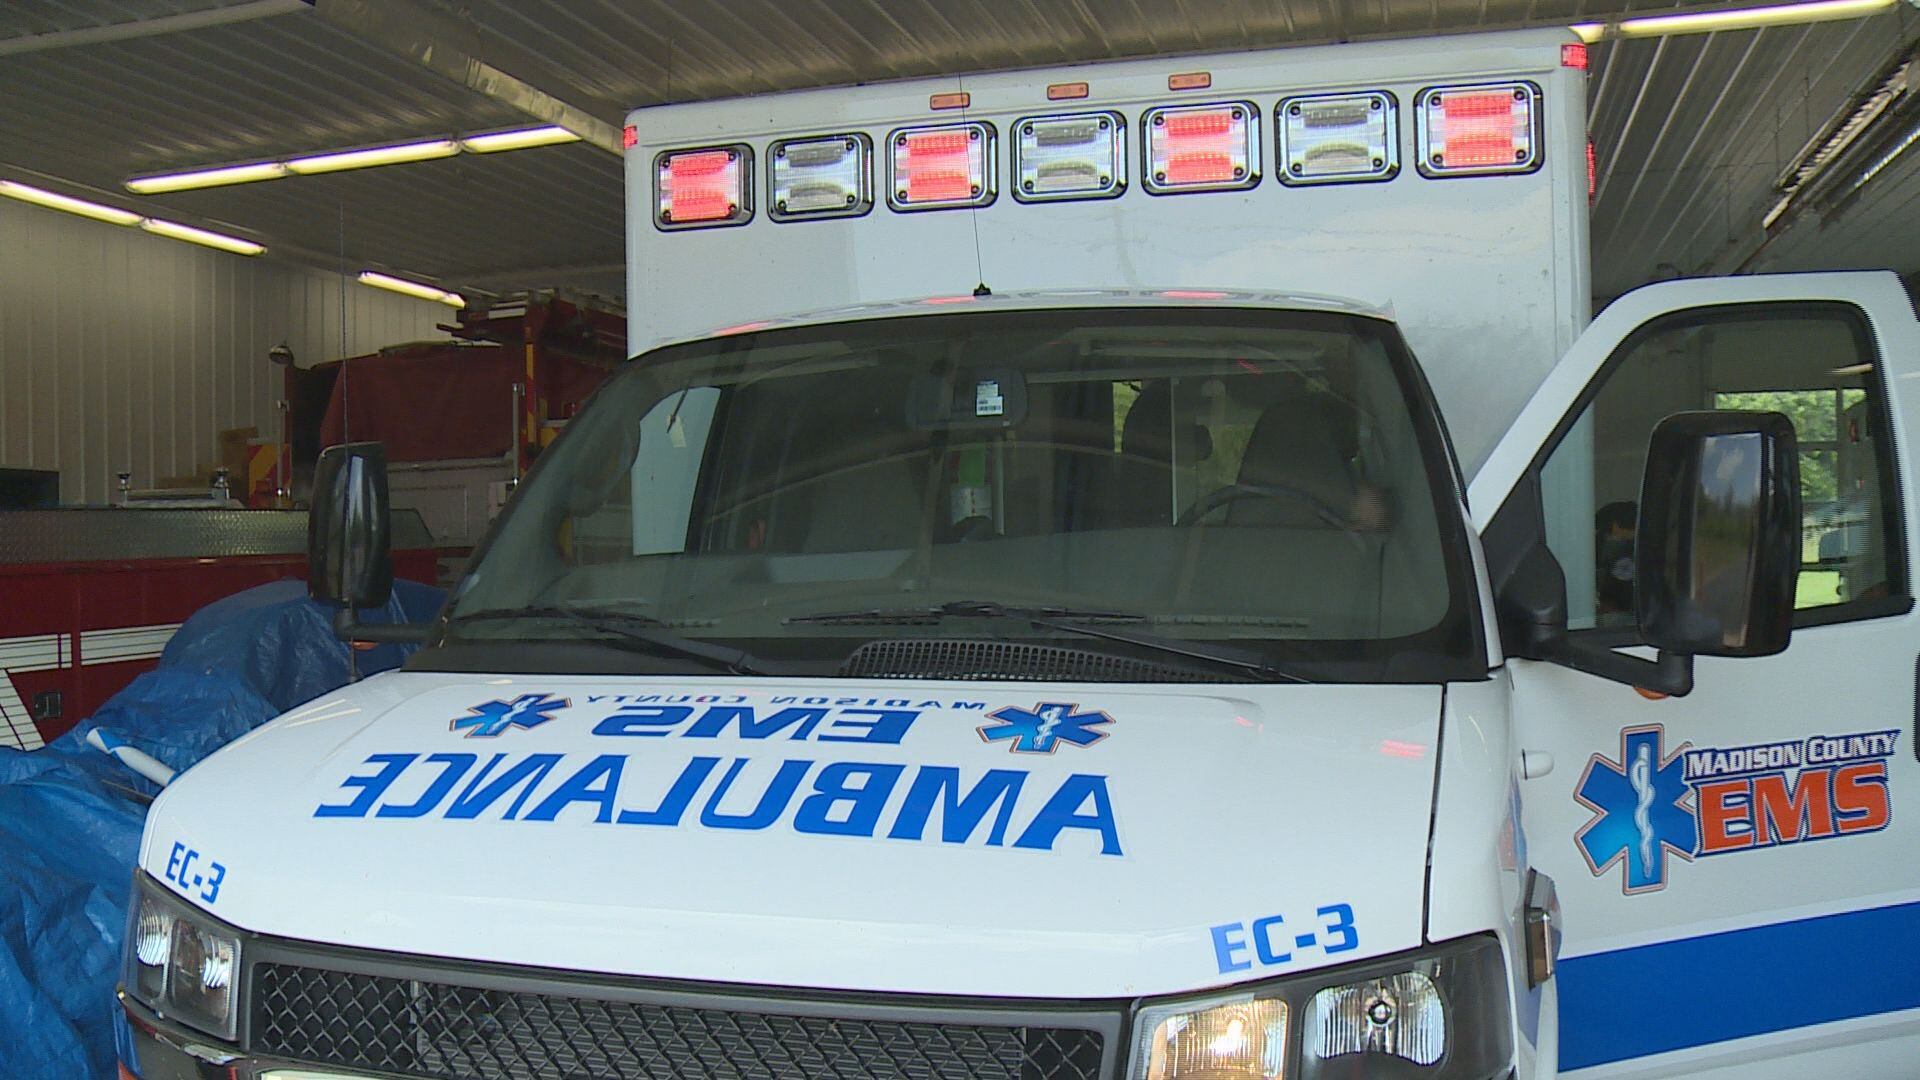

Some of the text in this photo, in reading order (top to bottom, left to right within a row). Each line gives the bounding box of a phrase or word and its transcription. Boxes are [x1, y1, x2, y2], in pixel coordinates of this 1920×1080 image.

[1696, 762, 1891, 854] EMS
[165, 841, 226, 904] EC-3
[1210, 903, 1359, 974] EC-3
